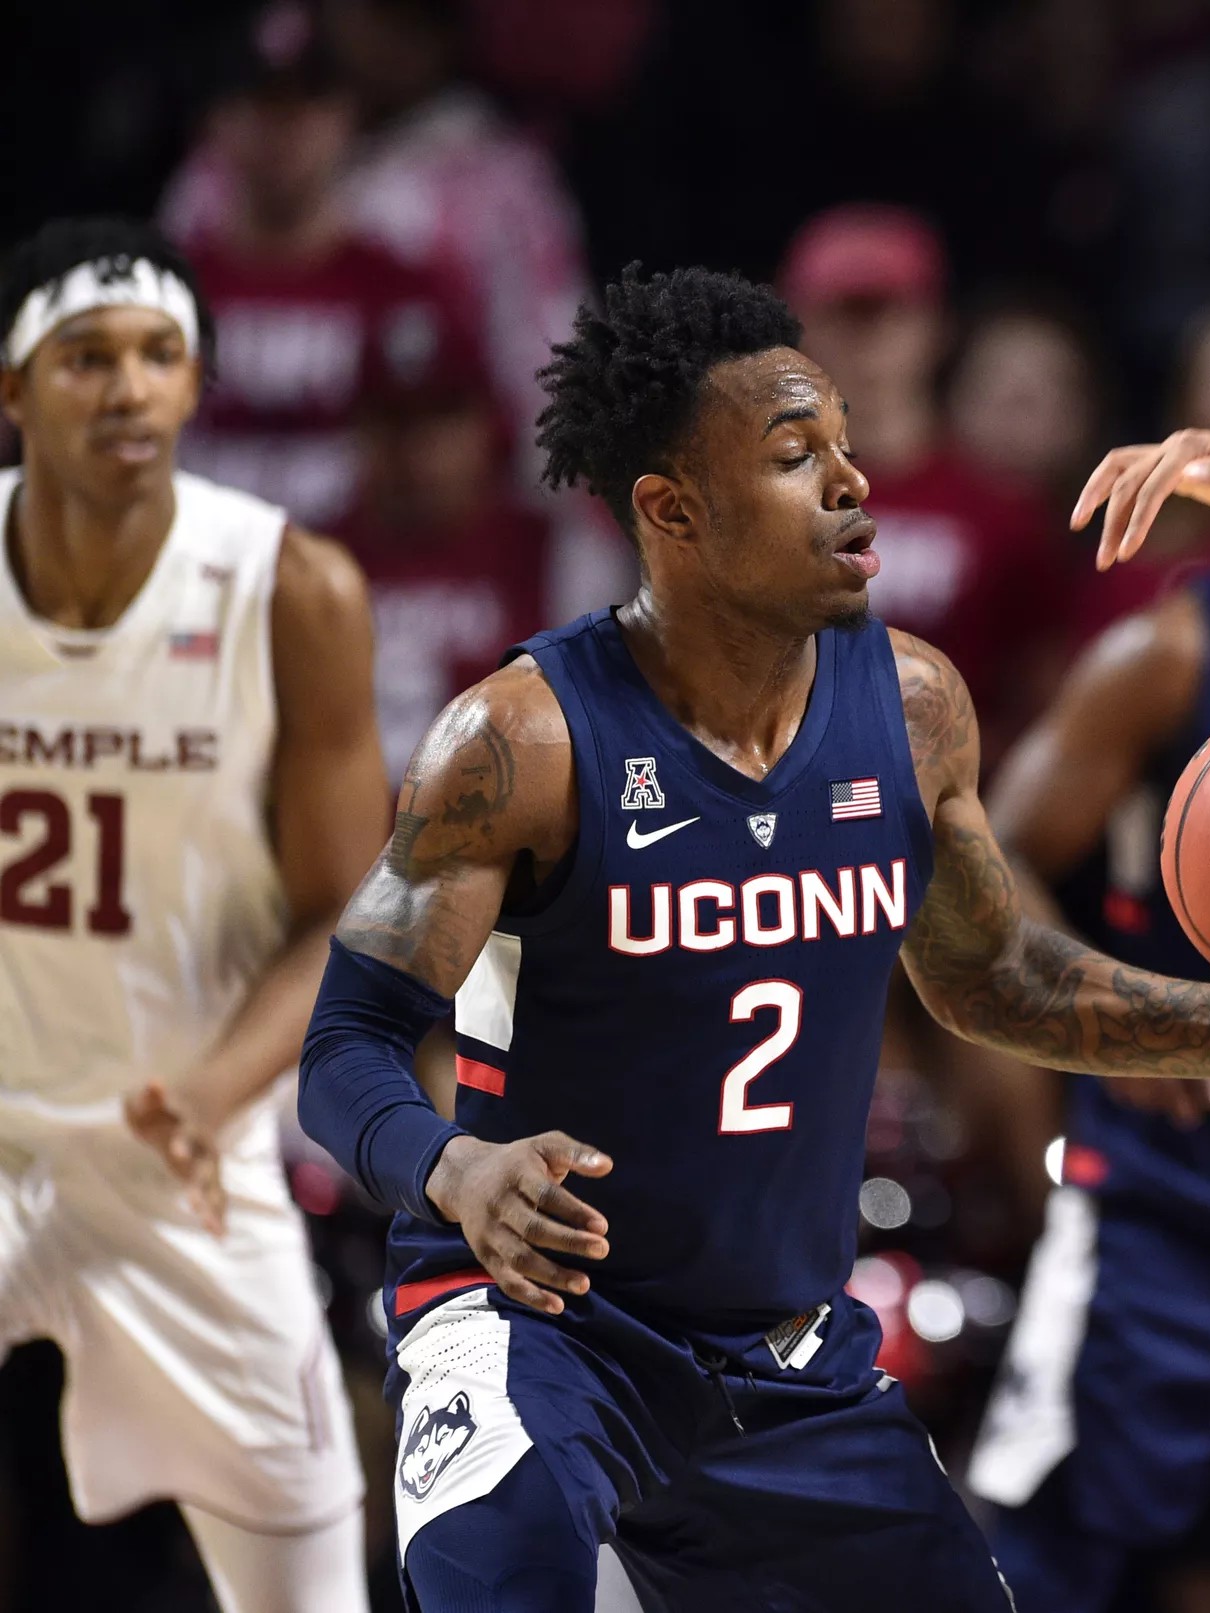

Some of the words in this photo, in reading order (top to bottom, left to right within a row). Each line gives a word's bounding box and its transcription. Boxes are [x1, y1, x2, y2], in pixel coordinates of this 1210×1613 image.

[0, 788, 132, 937] 21
[608, 858, 907, 957] UCONN
[718, 981, 804, 1136] 2
